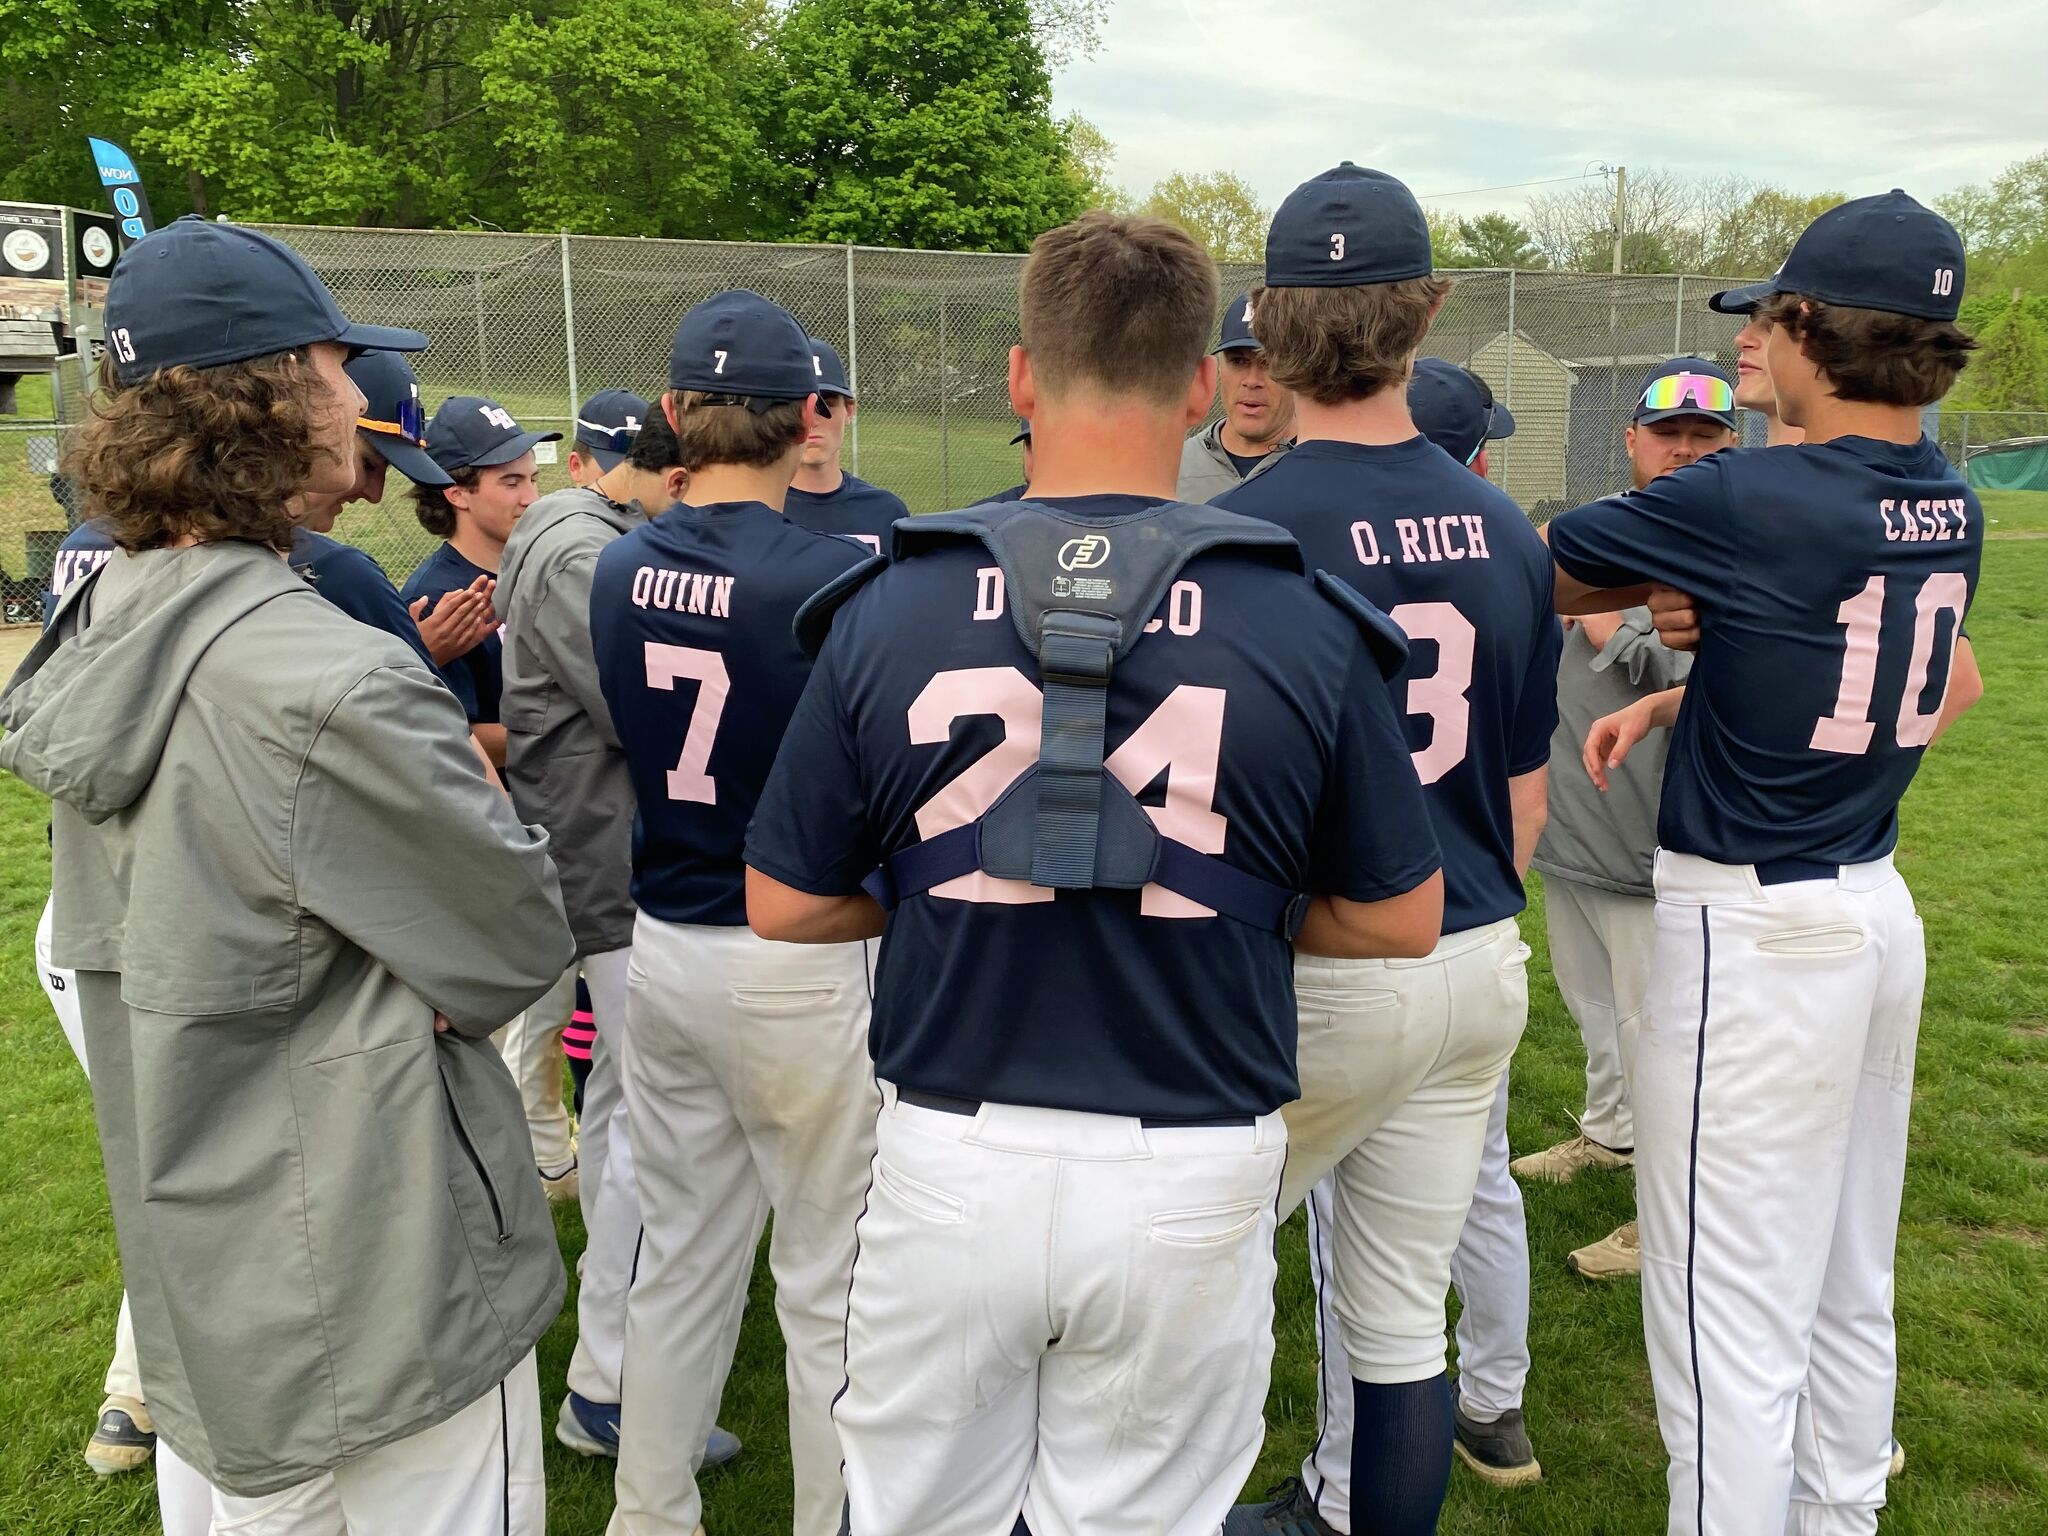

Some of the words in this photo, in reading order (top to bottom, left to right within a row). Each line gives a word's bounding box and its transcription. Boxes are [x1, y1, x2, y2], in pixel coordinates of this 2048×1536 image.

[1330, 233, 1345, 261] 3
[1932, 268, 1953, 296] 10
[111, 327, 136, 364] 13
[714, 350, 728, 375] 7
[1350, 520, 1391, 566] O.
[1394, 515, 1490, 563] RICH
[1880, 498, 1967, 542] CASEY
[631, 566, 735, 619] QUINN
[1808, 572, 1968, 755] 10
[1389, 602, 1476, 785] 3
[644, 641, 731, 805] 7
[907, 666, 1227, 919] 24
